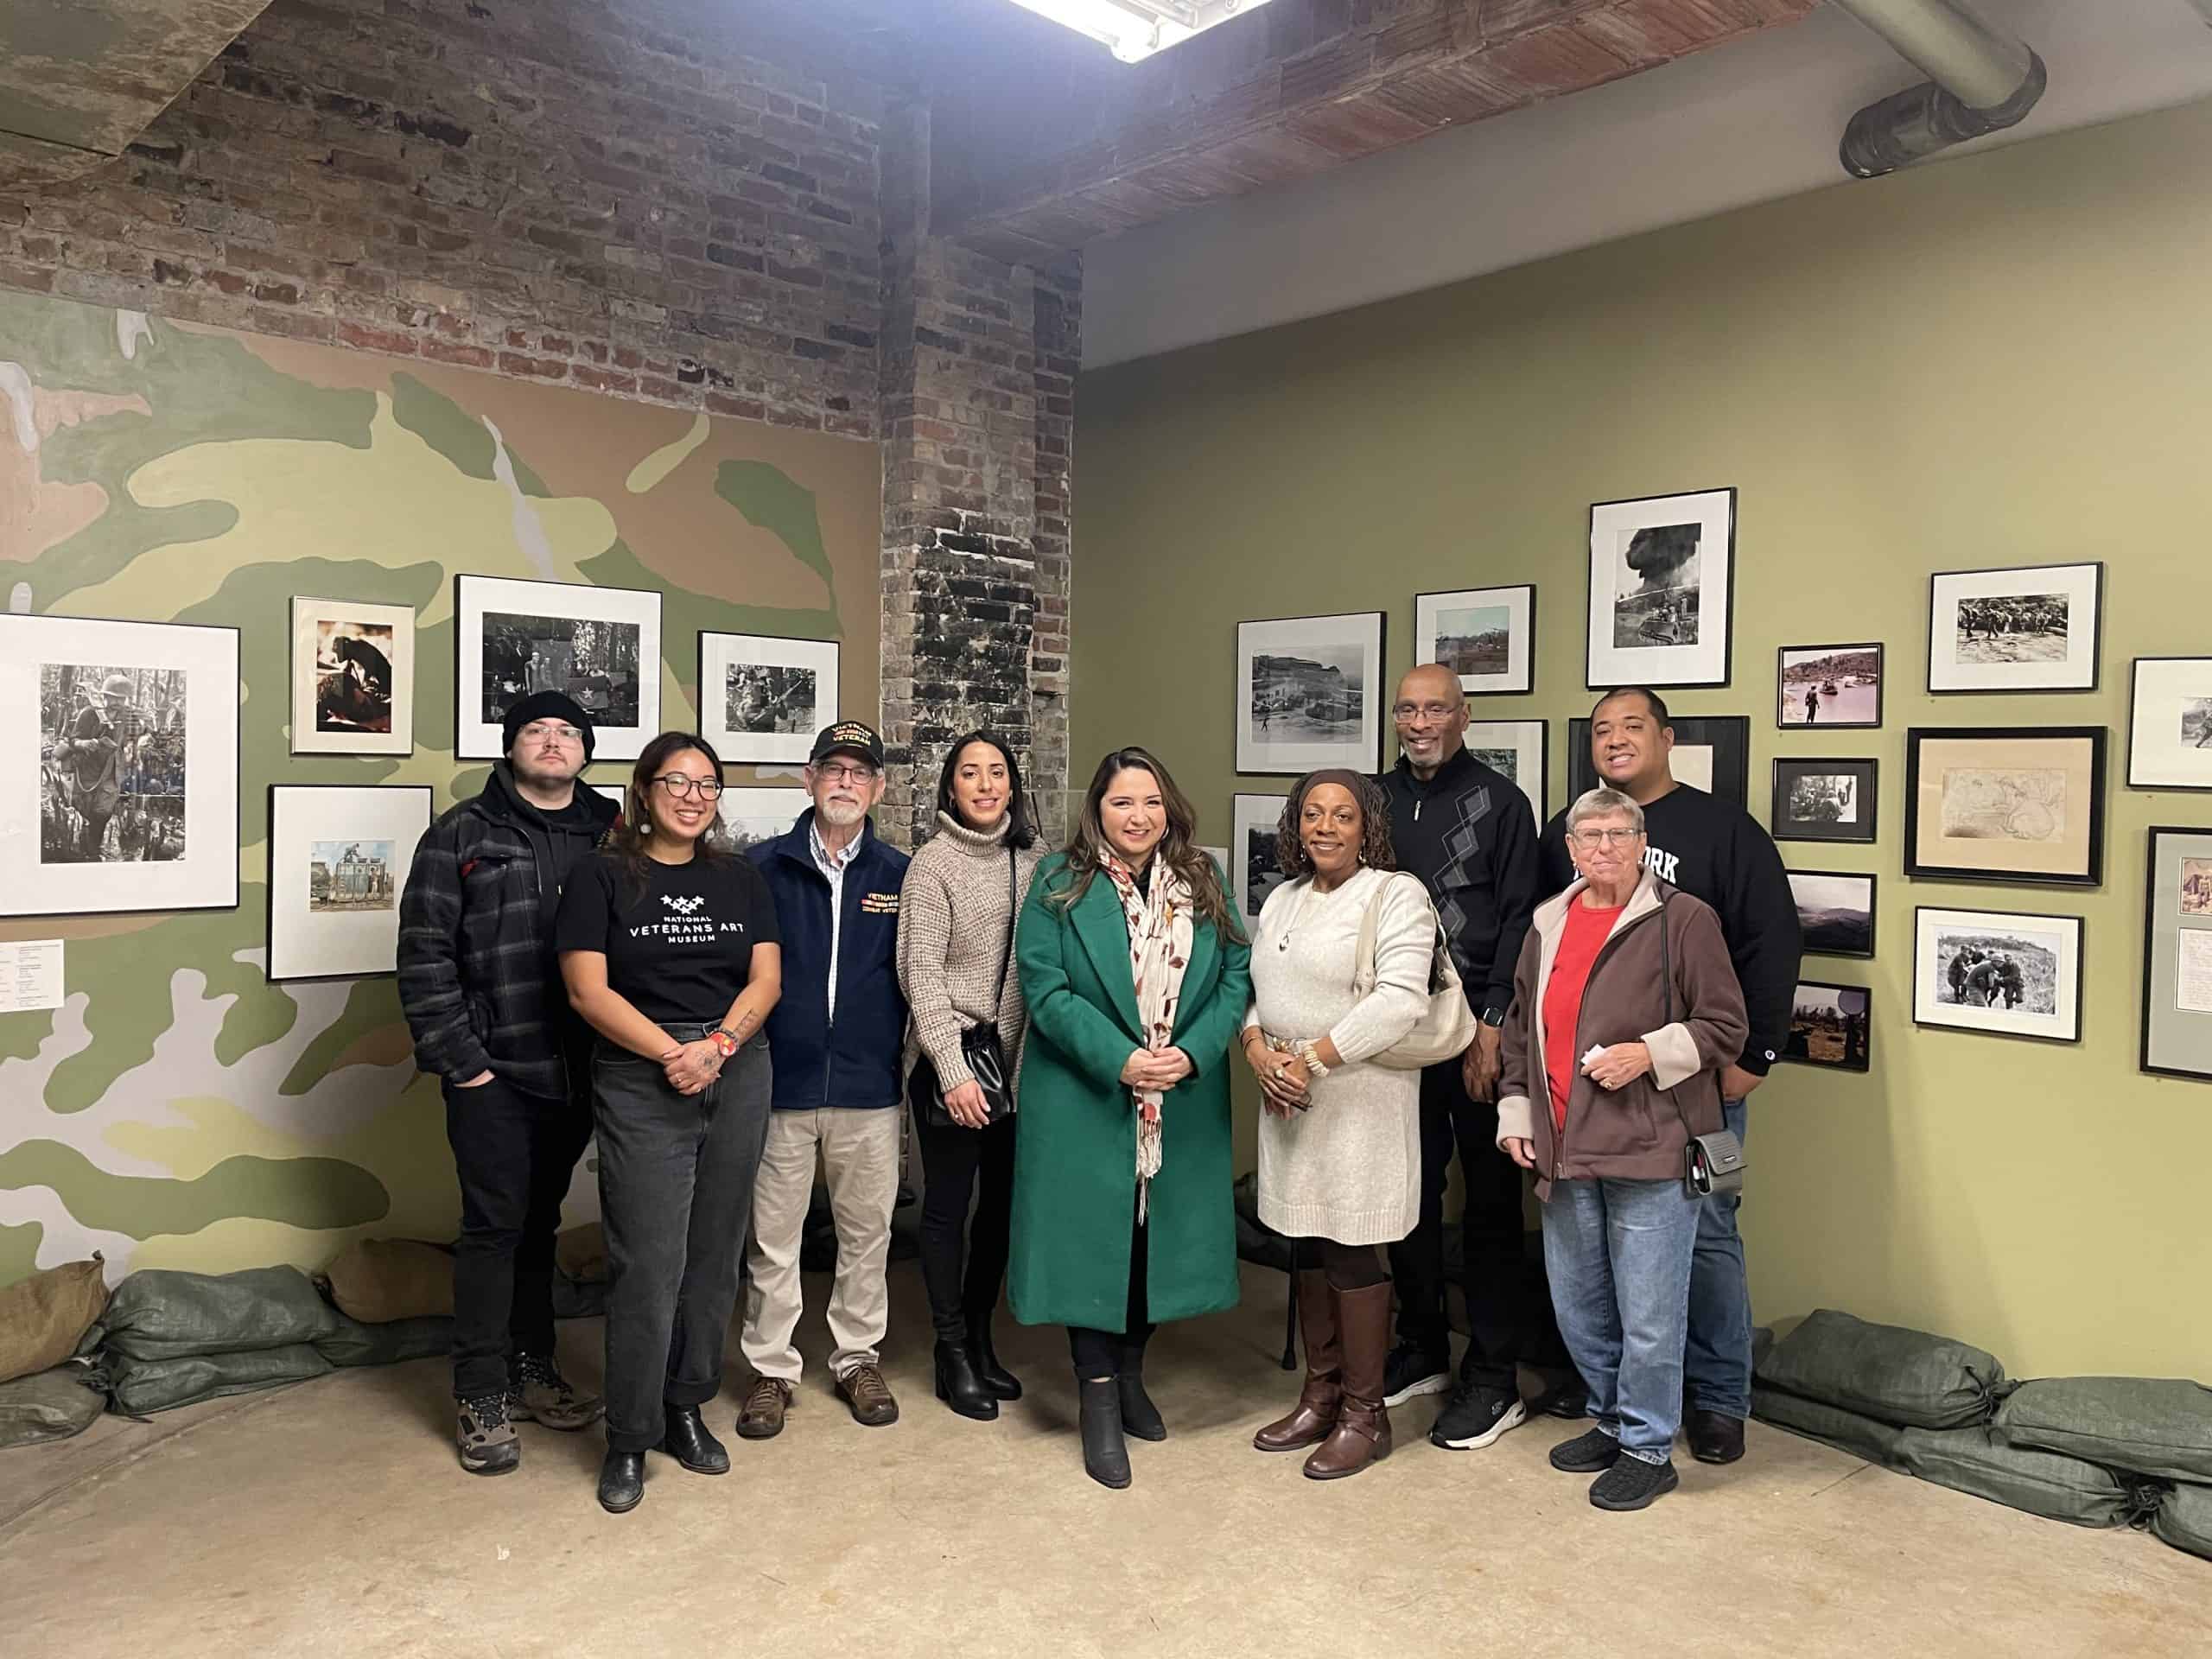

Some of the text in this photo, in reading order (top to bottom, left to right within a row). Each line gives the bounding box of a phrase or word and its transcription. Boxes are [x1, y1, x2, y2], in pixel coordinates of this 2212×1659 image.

[629, 922, 744, 938] VETERANS ART
[668, 934, 715, 944] MUSEUM
